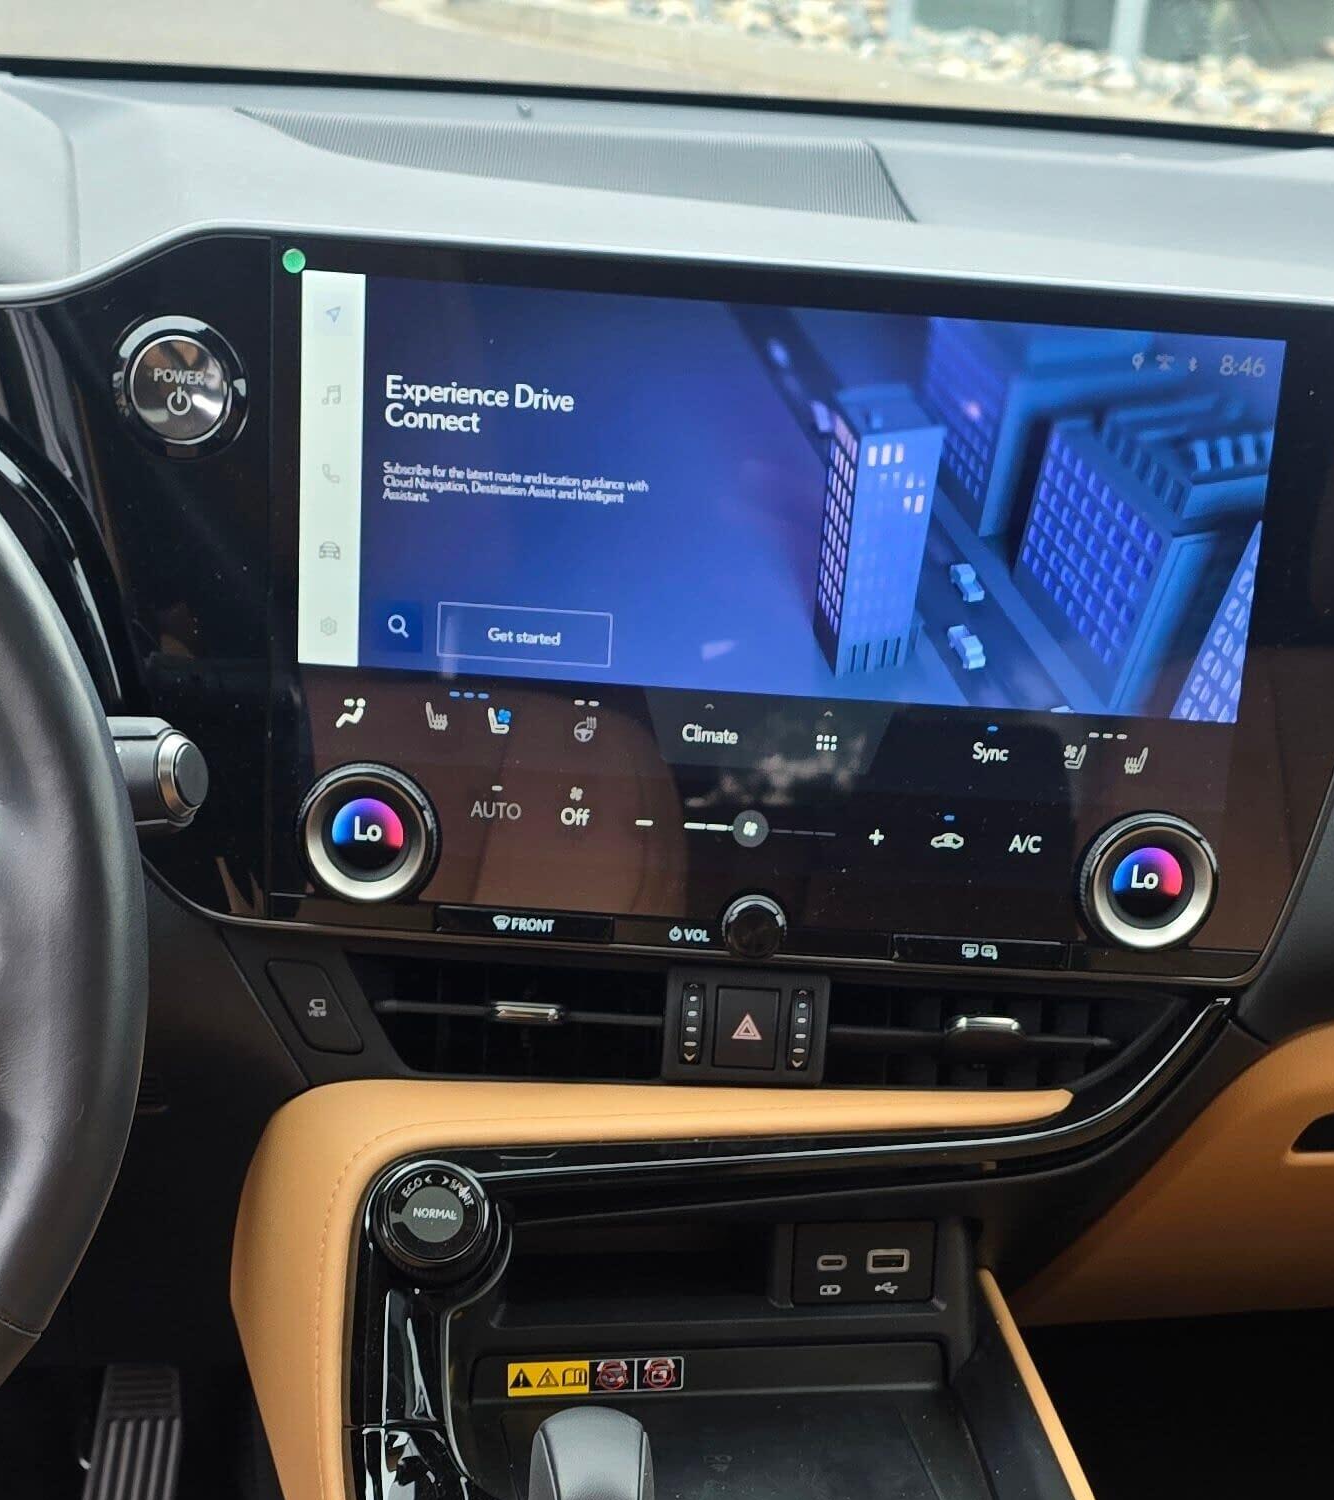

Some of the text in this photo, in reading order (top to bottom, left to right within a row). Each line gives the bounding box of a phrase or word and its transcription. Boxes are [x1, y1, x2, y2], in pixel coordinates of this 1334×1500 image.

[153, 367, 205, 386] POWER
[1219, 354, 1266, 378] 8:46
[386, 374, 575, 413] Experience Drive
[384, 402, 482, 434] Connect
[382, 461, 649, 493] Subscribe for the latest route and location guidance with
[382, 474, 414, 489] Cloud
[471, 480, 527, 497] Destination
[527, 485, 556, 499] Assist
[557, 487, 577, 500] and
[577, 488, 625, 504] Intelligent
[487, 627, 562, 646] Get started
[681, 723, 739, 745] Climate
[972, 741, 1009, 764] Sync
[470, 800, 522, 821] AUTO
[560, 806, 591, 827] Off
[353, 815, 383, 843] Lo
[1008, 834, 1043, 854] A/C
[1130, 863, 1160, 890] Lo
[510, 917, 556, 933] FRONT
[684, 928, 711, 943] VOL
[400, 1177, 424, 1199] ECO
[413, 1207, 458, 1221] NORMAL
